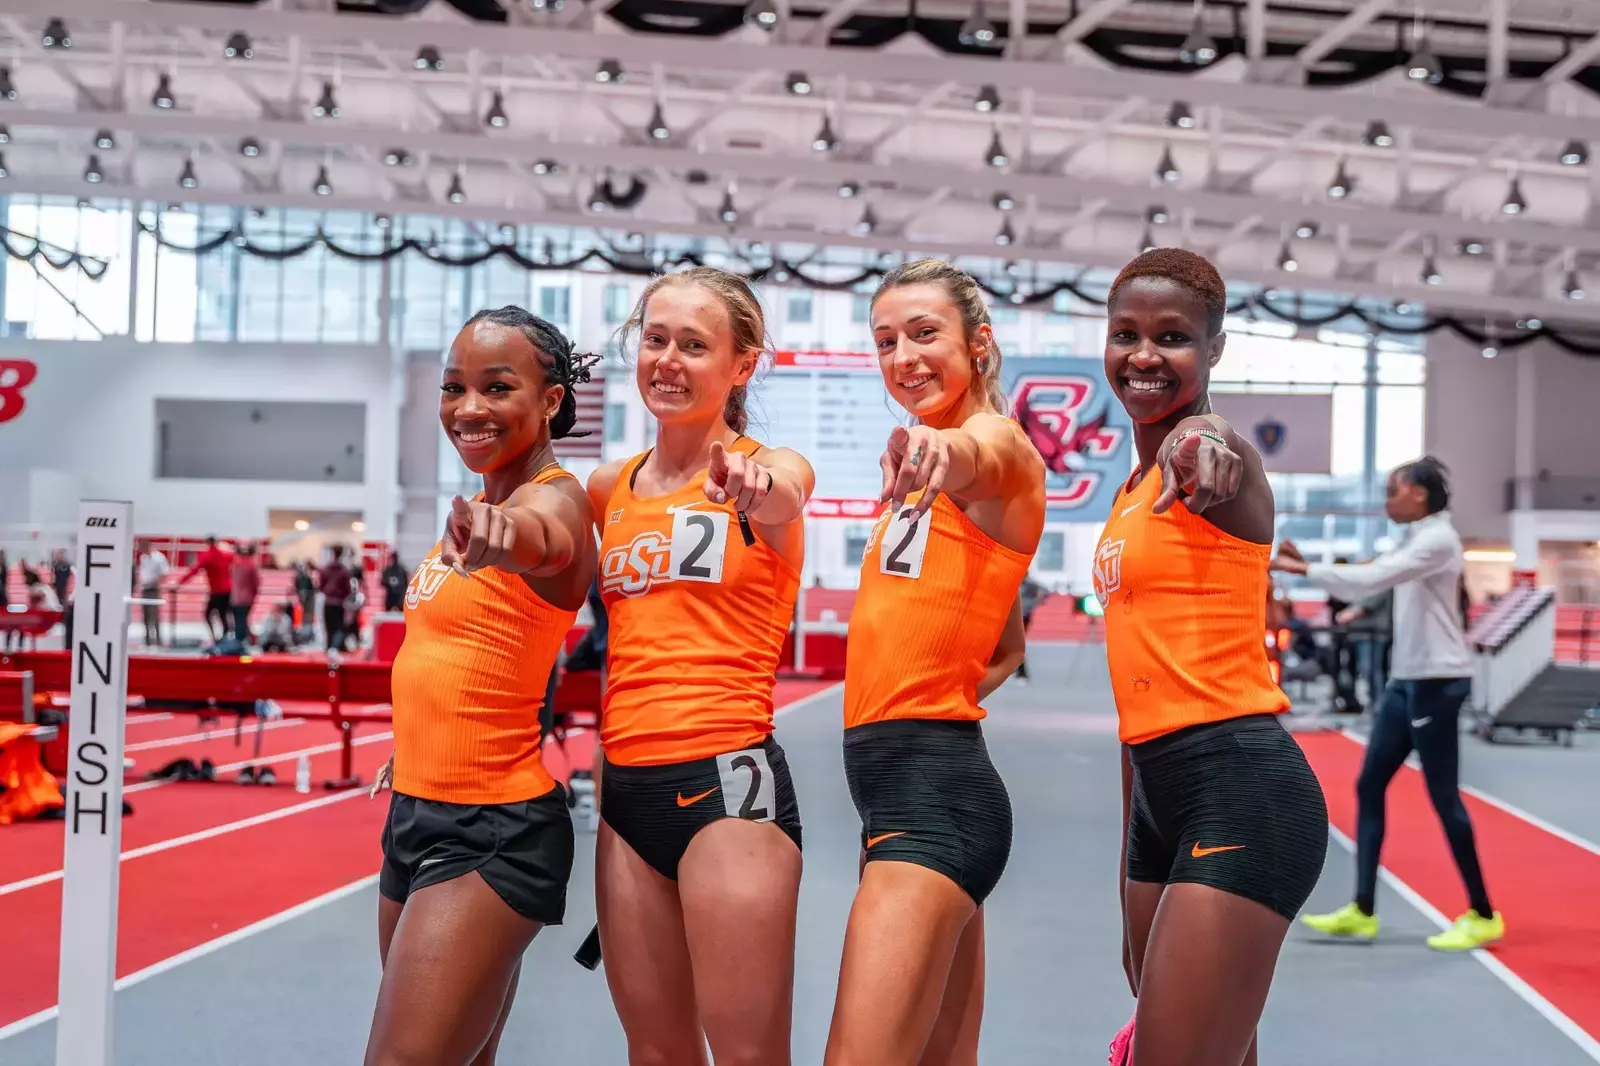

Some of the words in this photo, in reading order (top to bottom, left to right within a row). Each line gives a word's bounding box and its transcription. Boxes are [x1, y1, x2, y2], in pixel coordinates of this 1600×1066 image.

[86, 517, 117, 528] GILL
[679, 514, 715, 578] 2
[886, 508, 918, 574] 2
[73, 545, 115, 834] FINISH
[730, 755, 768, 819] 2
